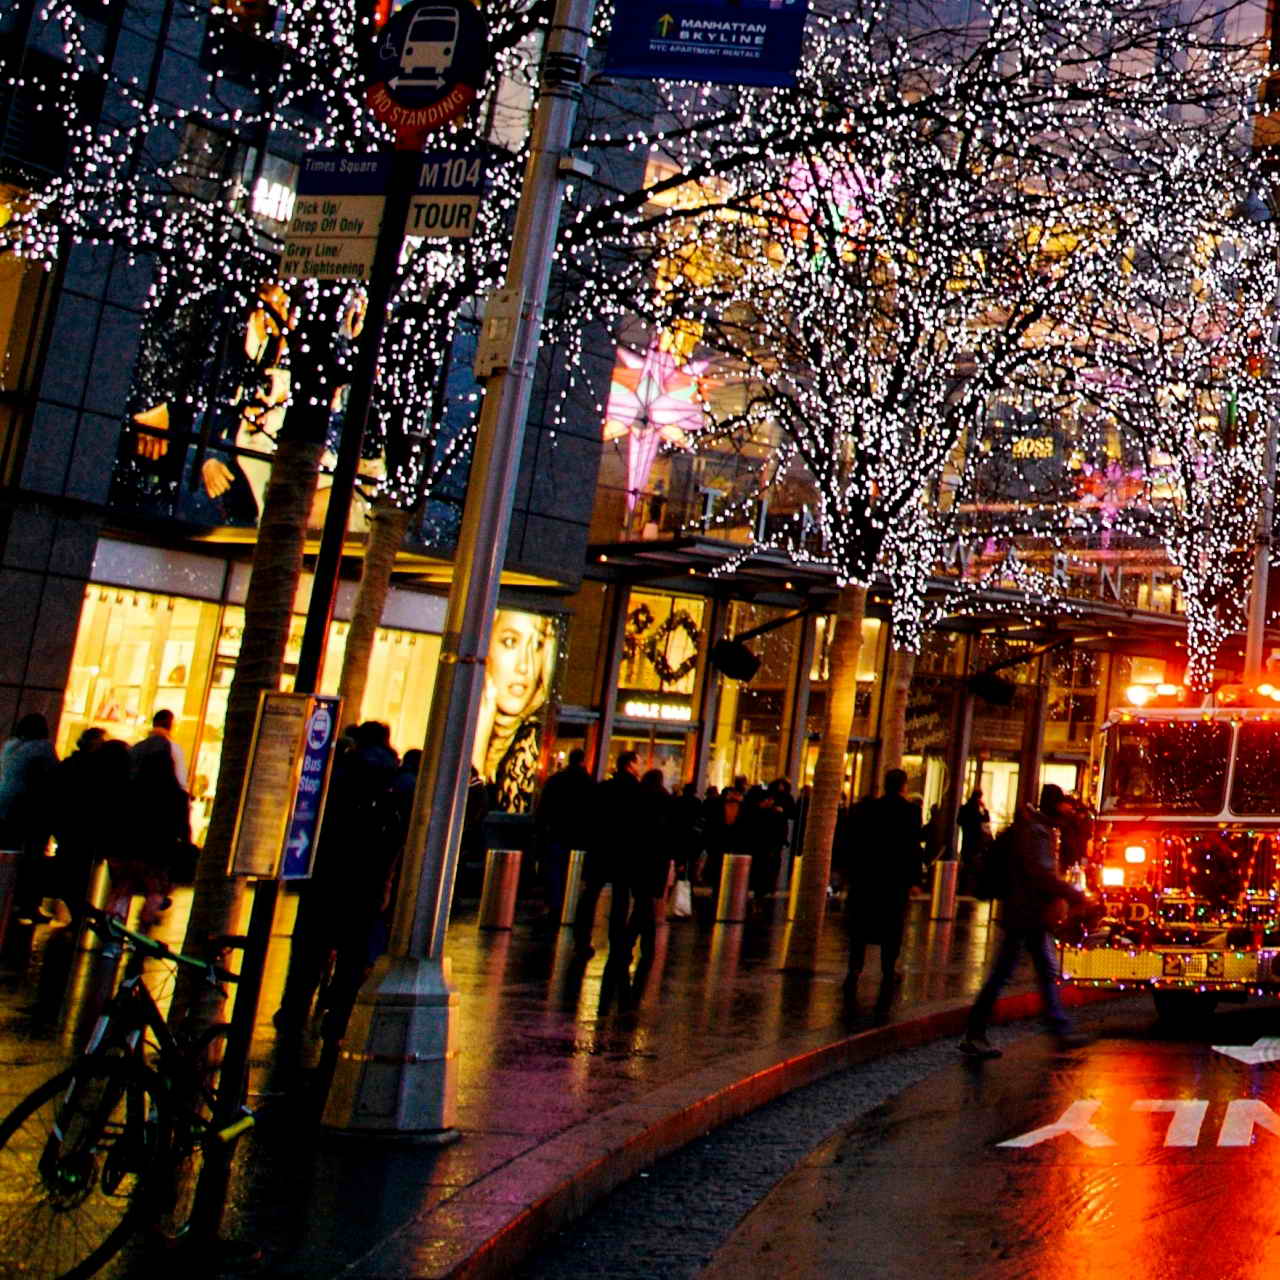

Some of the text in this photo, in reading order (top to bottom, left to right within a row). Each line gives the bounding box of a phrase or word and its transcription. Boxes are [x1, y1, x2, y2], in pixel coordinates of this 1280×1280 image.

[680, 19, 767, 34] MANHATTAN
[679, 30, 765, 45] SKYLINE
[649, 43, 668, 53] NYC
[669, 45, 721, 57] APARTMENT
[372, 89, 464, 126] NO STANDING
[304, 158, 378, 174] Times Square
[296, 201, 318, 215] Pick
[413, 203, 473, 229] TOUR
[292, 218, 365, 234] Drop Off Only
[286, 243, 312, 259] Gray
[302, 260, 365, 276] Sightseeing
[303, 755, 322, 772] Bus
